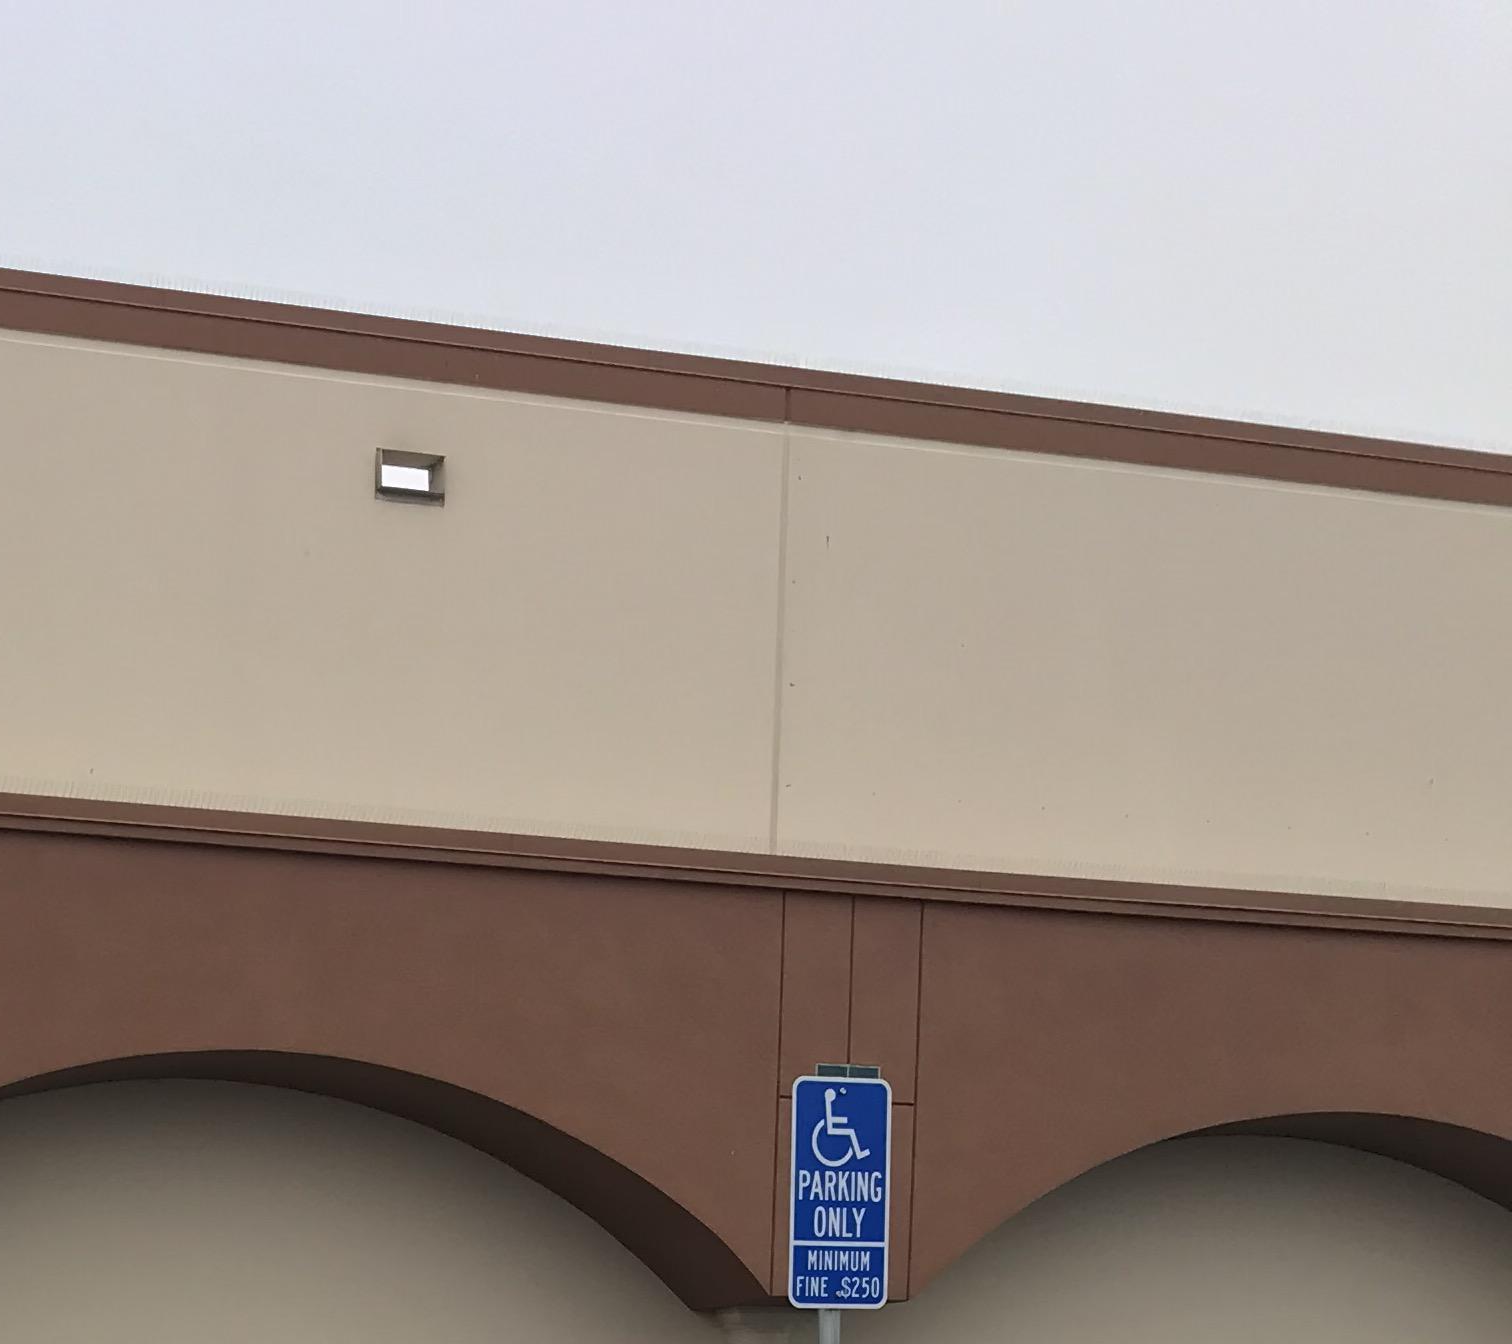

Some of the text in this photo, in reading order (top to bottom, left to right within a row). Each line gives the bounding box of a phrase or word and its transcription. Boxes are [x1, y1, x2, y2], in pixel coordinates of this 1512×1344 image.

[798, 1169, 883, 1203] PARKING
[813, 1205, 866, 1238] ONLY
[807, 1250, 871, 1272] MINIMUM
[796, 1276, 880, 1299] FINE $250
